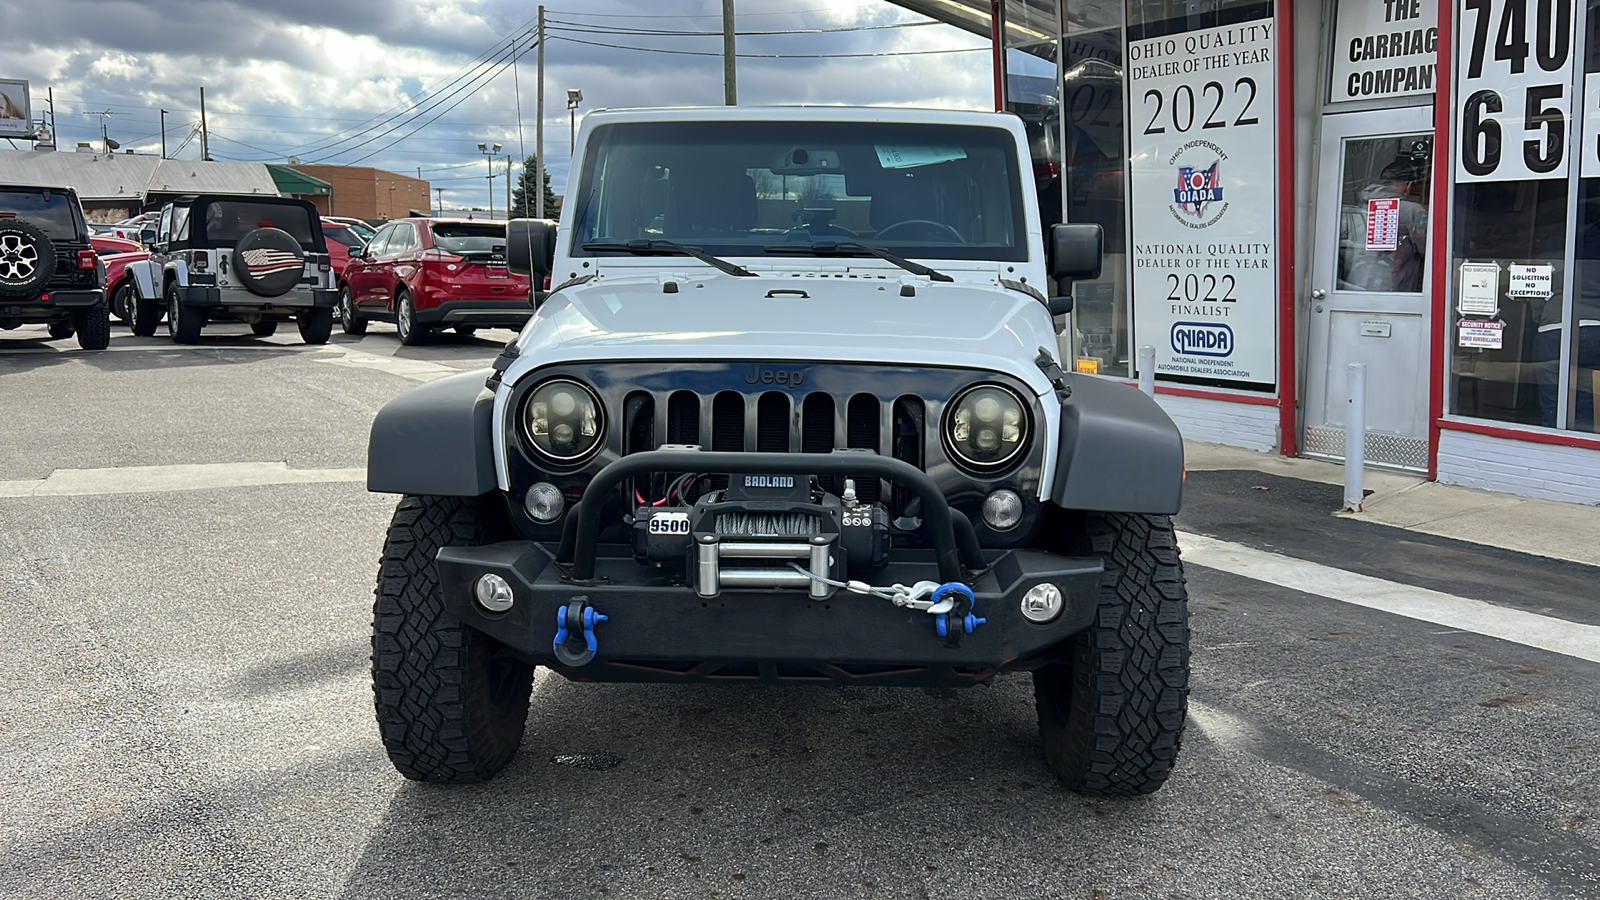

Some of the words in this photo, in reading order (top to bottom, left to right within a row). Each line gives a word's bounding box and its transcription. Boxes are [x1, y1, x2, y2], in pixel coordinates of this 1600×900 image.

[1384, 0, 1420, 22] THE
[1131, 40, 1176, 60] OHIO
[1185, 23, 1272, 54] QUALITY
[1349, 27, 1438, 62] CARRIAG
[1465, 0, 1570, 79] 740
[1133, 61, 1180, 80] DEALER
[1183, 58, 1200, 73] OF
[1203, 54, 1230, 70] THE
[1233, 48, 1270, 66] YEAR
[1143, 77, 1259, 135] 2022
[1169, 147, 1184, 165] OHIO
[1183, 139, 1228, 161] INDEPENDENT
[1180, 189, 1215, 202] OIADA
[1168, 204, 1190, 228] AUTOMOBILE
[1207, 201, 1230, 227] ASSOCIATION
[1135, 244, 1202, 255] NATIONAL
[1207, 243, 1271, 256] QUALITY
[1137, 258, 1181, 268] DEALER
[1186, 258, 1201, 268] OF
[1206, 258, 1230, 268] THE
[1235, 258, 1269, 269] YEAR
[1166, 273, 1237, 303] 2022
[1171, 304, 1231, 316] FINALIST
[1175, 329, 1228, 350] NIADA
[1157, 364, 1189, 373] AUTOMOBILE
[1190, 366, 1213, 375] DEALERS
[1213, 368, 1250, 378] ASSOCIATION
[1171, 356, 1197, 364] NATIONAL
[1197, 358, 1234, 367] INDEPENDENT
[744, 364, 804, 389] Jeep
[744, 475, 794, 488] BADLAND
[650, 519, 690, 533] 9500
